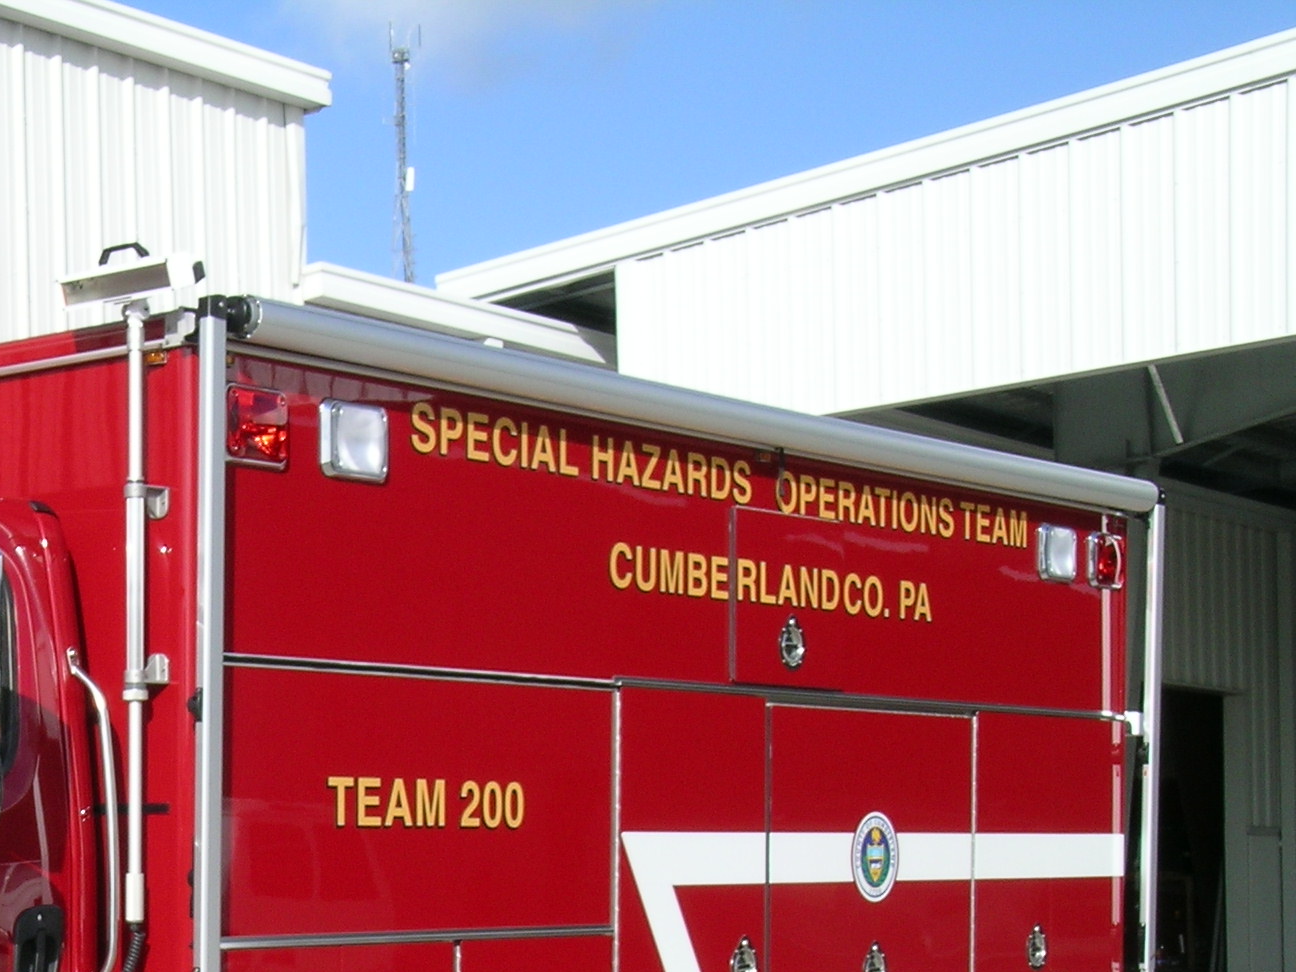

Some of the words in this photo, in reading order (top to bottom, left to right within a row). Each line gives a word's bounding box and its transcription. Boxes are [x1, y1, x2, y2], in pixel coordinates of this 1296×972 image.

[410, 402, 579, 477] SPECIAL
[591, 435, 753, 505] HAZARDS
[775, 471, 955, 539] OPERATIONS
[960, 502, 1028, 549] TEAM
[899, 580, 933, 622] PA
[327, 776, 446, 828] TEAM
[460, 780, 525, 829] 200
